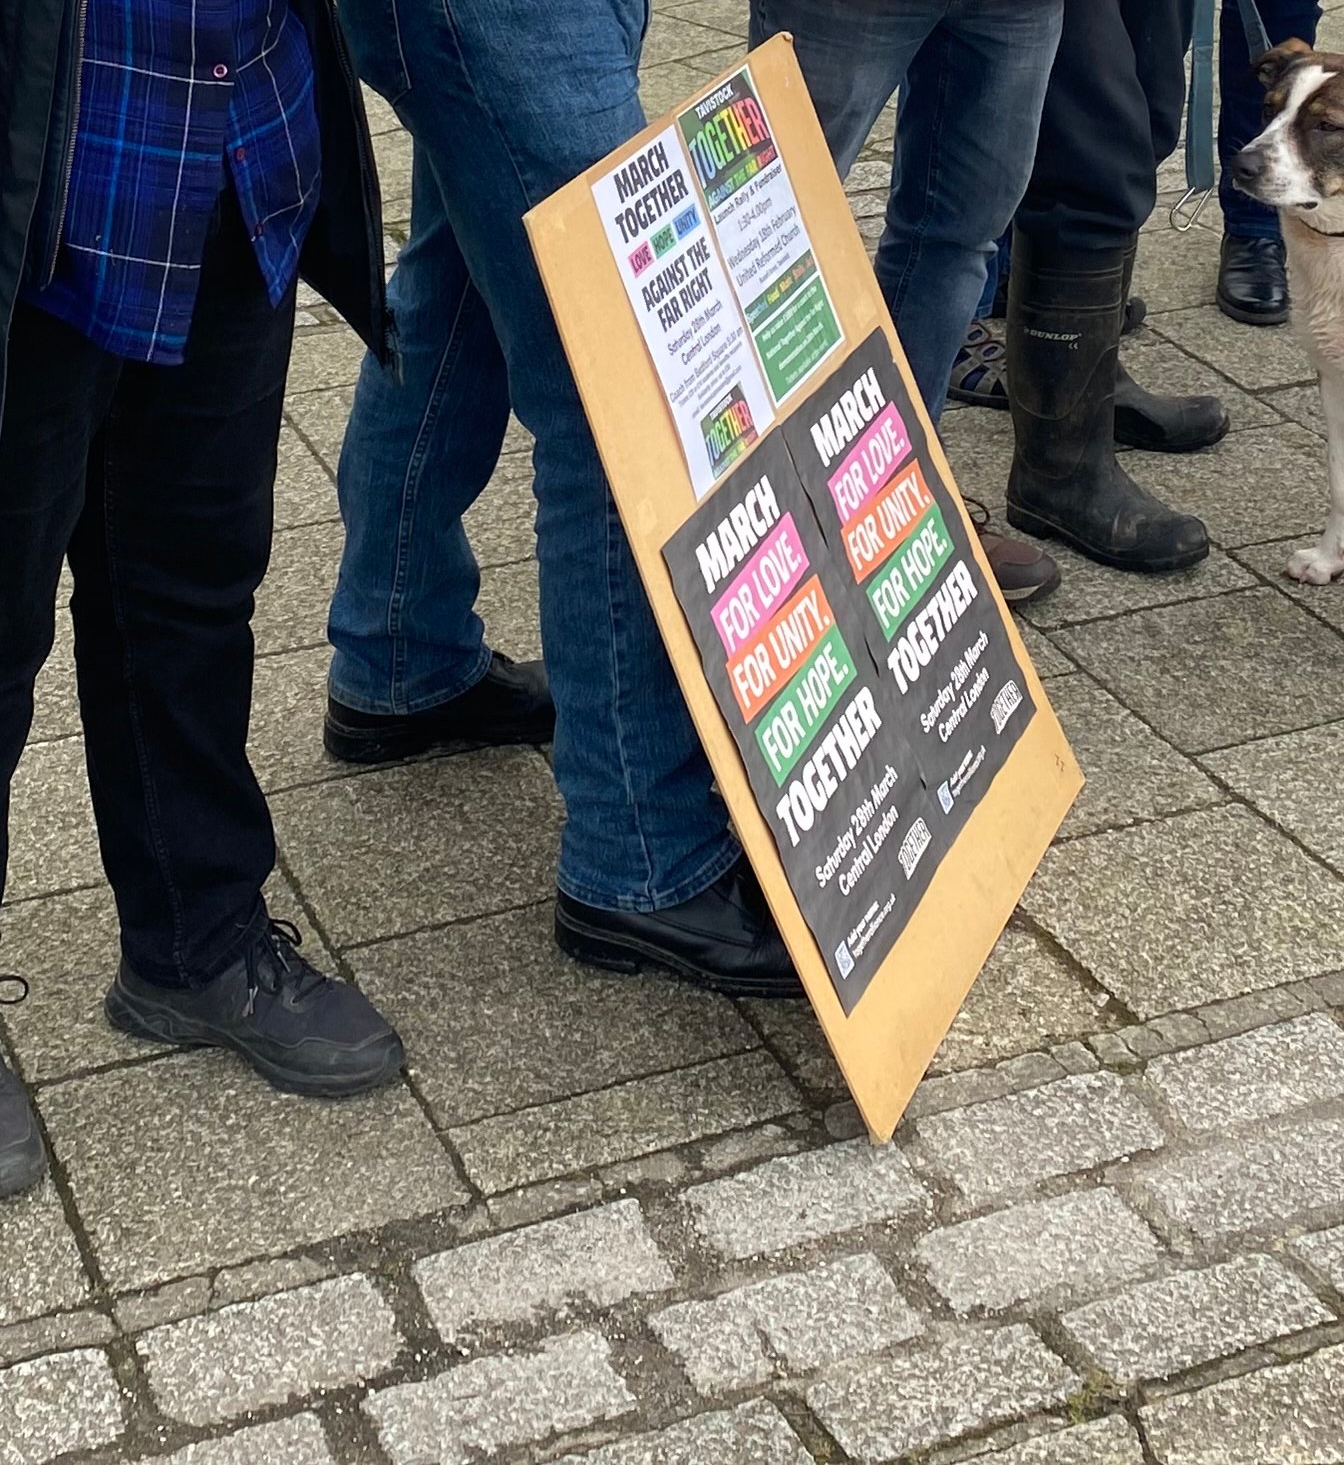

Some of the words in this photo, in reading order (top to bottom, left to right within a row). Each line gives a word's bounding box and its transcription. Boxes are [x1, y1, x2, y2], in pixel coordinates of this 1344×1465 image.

[689, 97, 771, 190] TOGETHER
[695, 83, 734, 120] TAVISTOCK
[613, 140, 670, 204] MARCH
[614, 168, 689, 244] TOGETHER
[630, 246, 652, 274] LOVE
[653, 227, 675, 254] HOPE
[674, 206, 698, 236] UNITY
[641, 255, 690, 313] AGAINST
[686, 236, 711, 271] THE
[656, 294, 684, 333] FAR
[680, 267, 714, 314] RIGHT
[1029, 329, 1079, 341] DUNLOP
[810, 367, 886, 468] MARCH
[834, 460, 871, 522] FOR
[861, 417, 905, 485] LOVE.
[695, 474, 781, 594] MARCH
[847, 509, 885, 571] FOR
[878, 471, 931, 541] UNITY.
[719, 583, 760, 652] FOR
[752, 530, 802, 610] LOVE.
[872, 567, 910, 630] FOR
[901, 517, 947, 592] HOPE.
[733, 642, 776, 709] FOR
[769, 590, 831, 669] UNITY.
[888, 559, 978, 695] TOGETHER
[763, 701, 806, 772] FOR
[796, 642, 849, 726] HOPE.
[776, 686, 882, 848] TOGETHER
